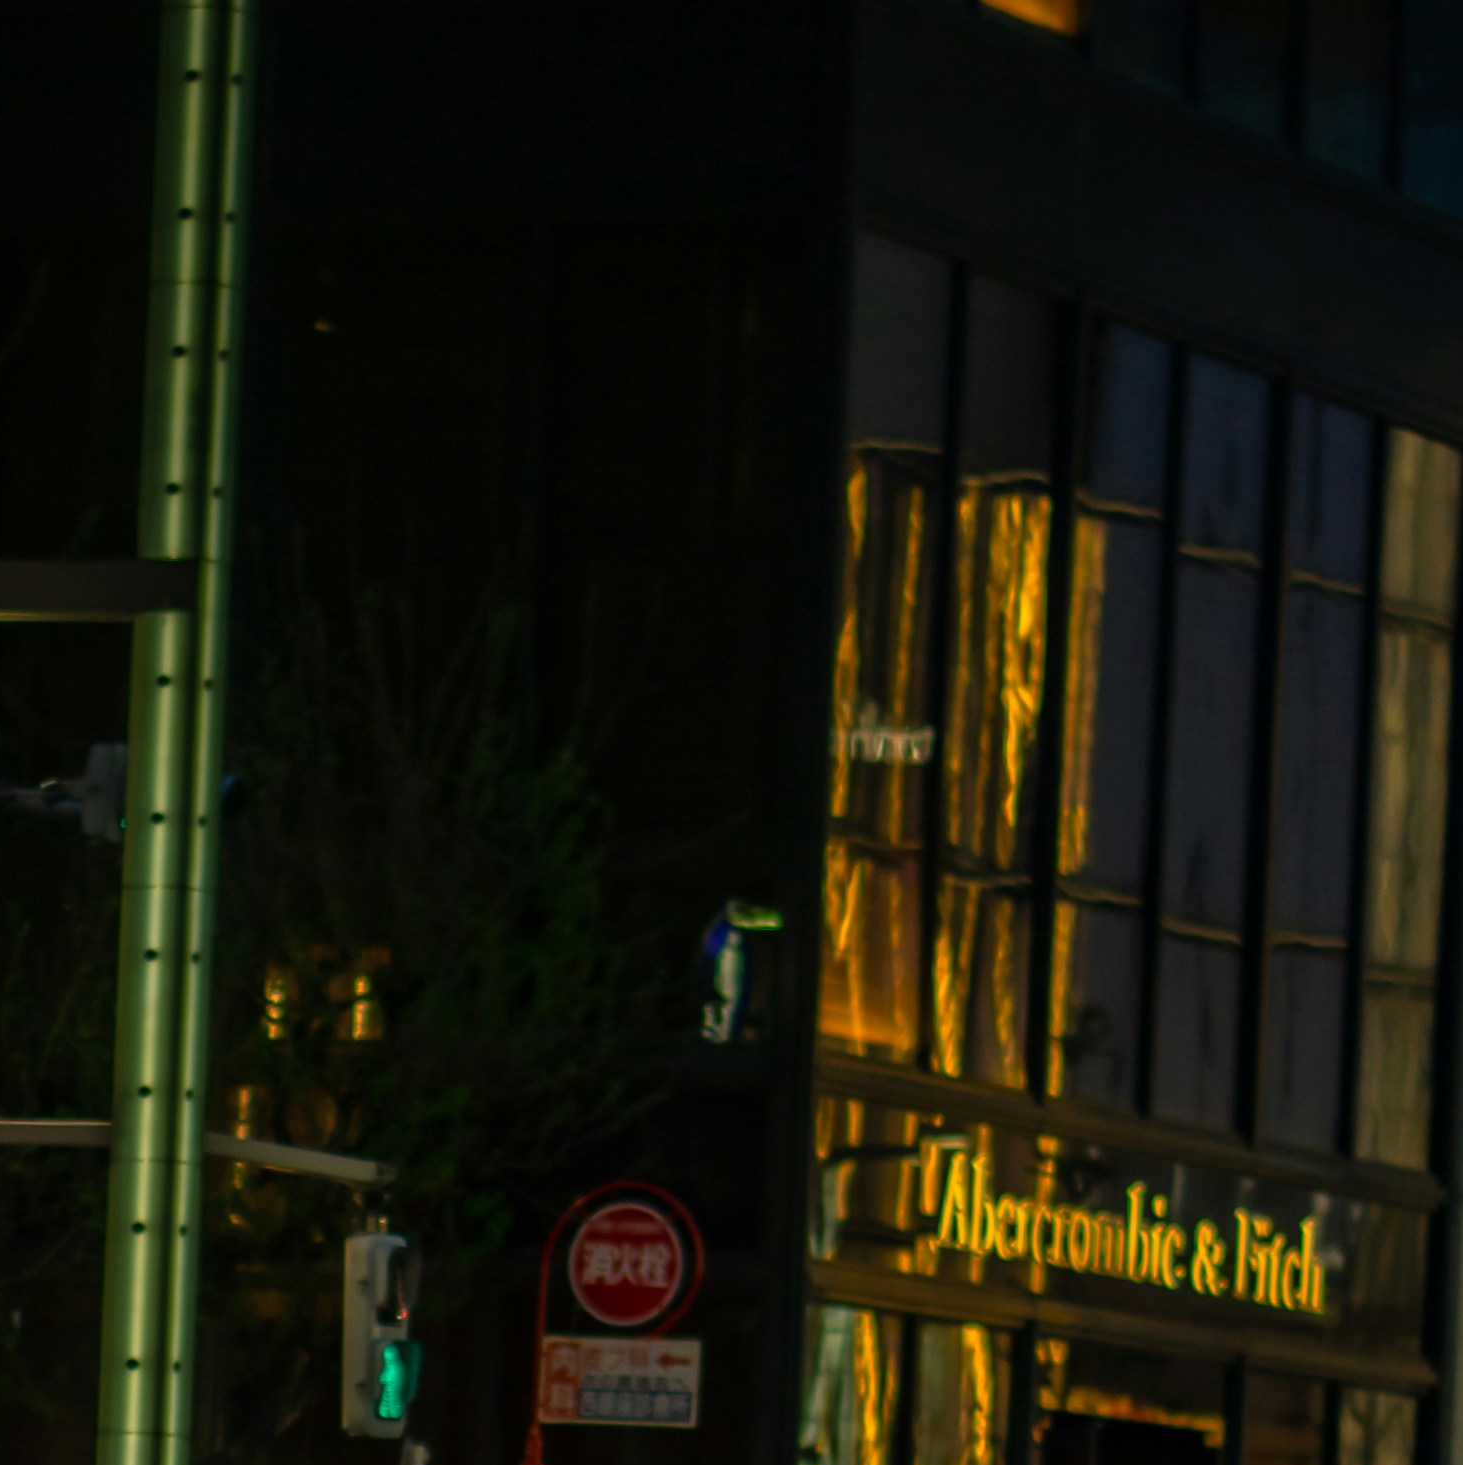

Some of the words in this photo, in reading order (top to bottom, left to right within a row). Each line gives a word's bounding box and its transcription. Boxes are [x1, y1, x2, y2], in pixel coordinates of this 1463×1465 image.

[936, 1151, 1187, 1291] Abercrombie
[1190, 1217, 1229, 1298] &
[1233, 1207, 1325, 1316] Fitch
